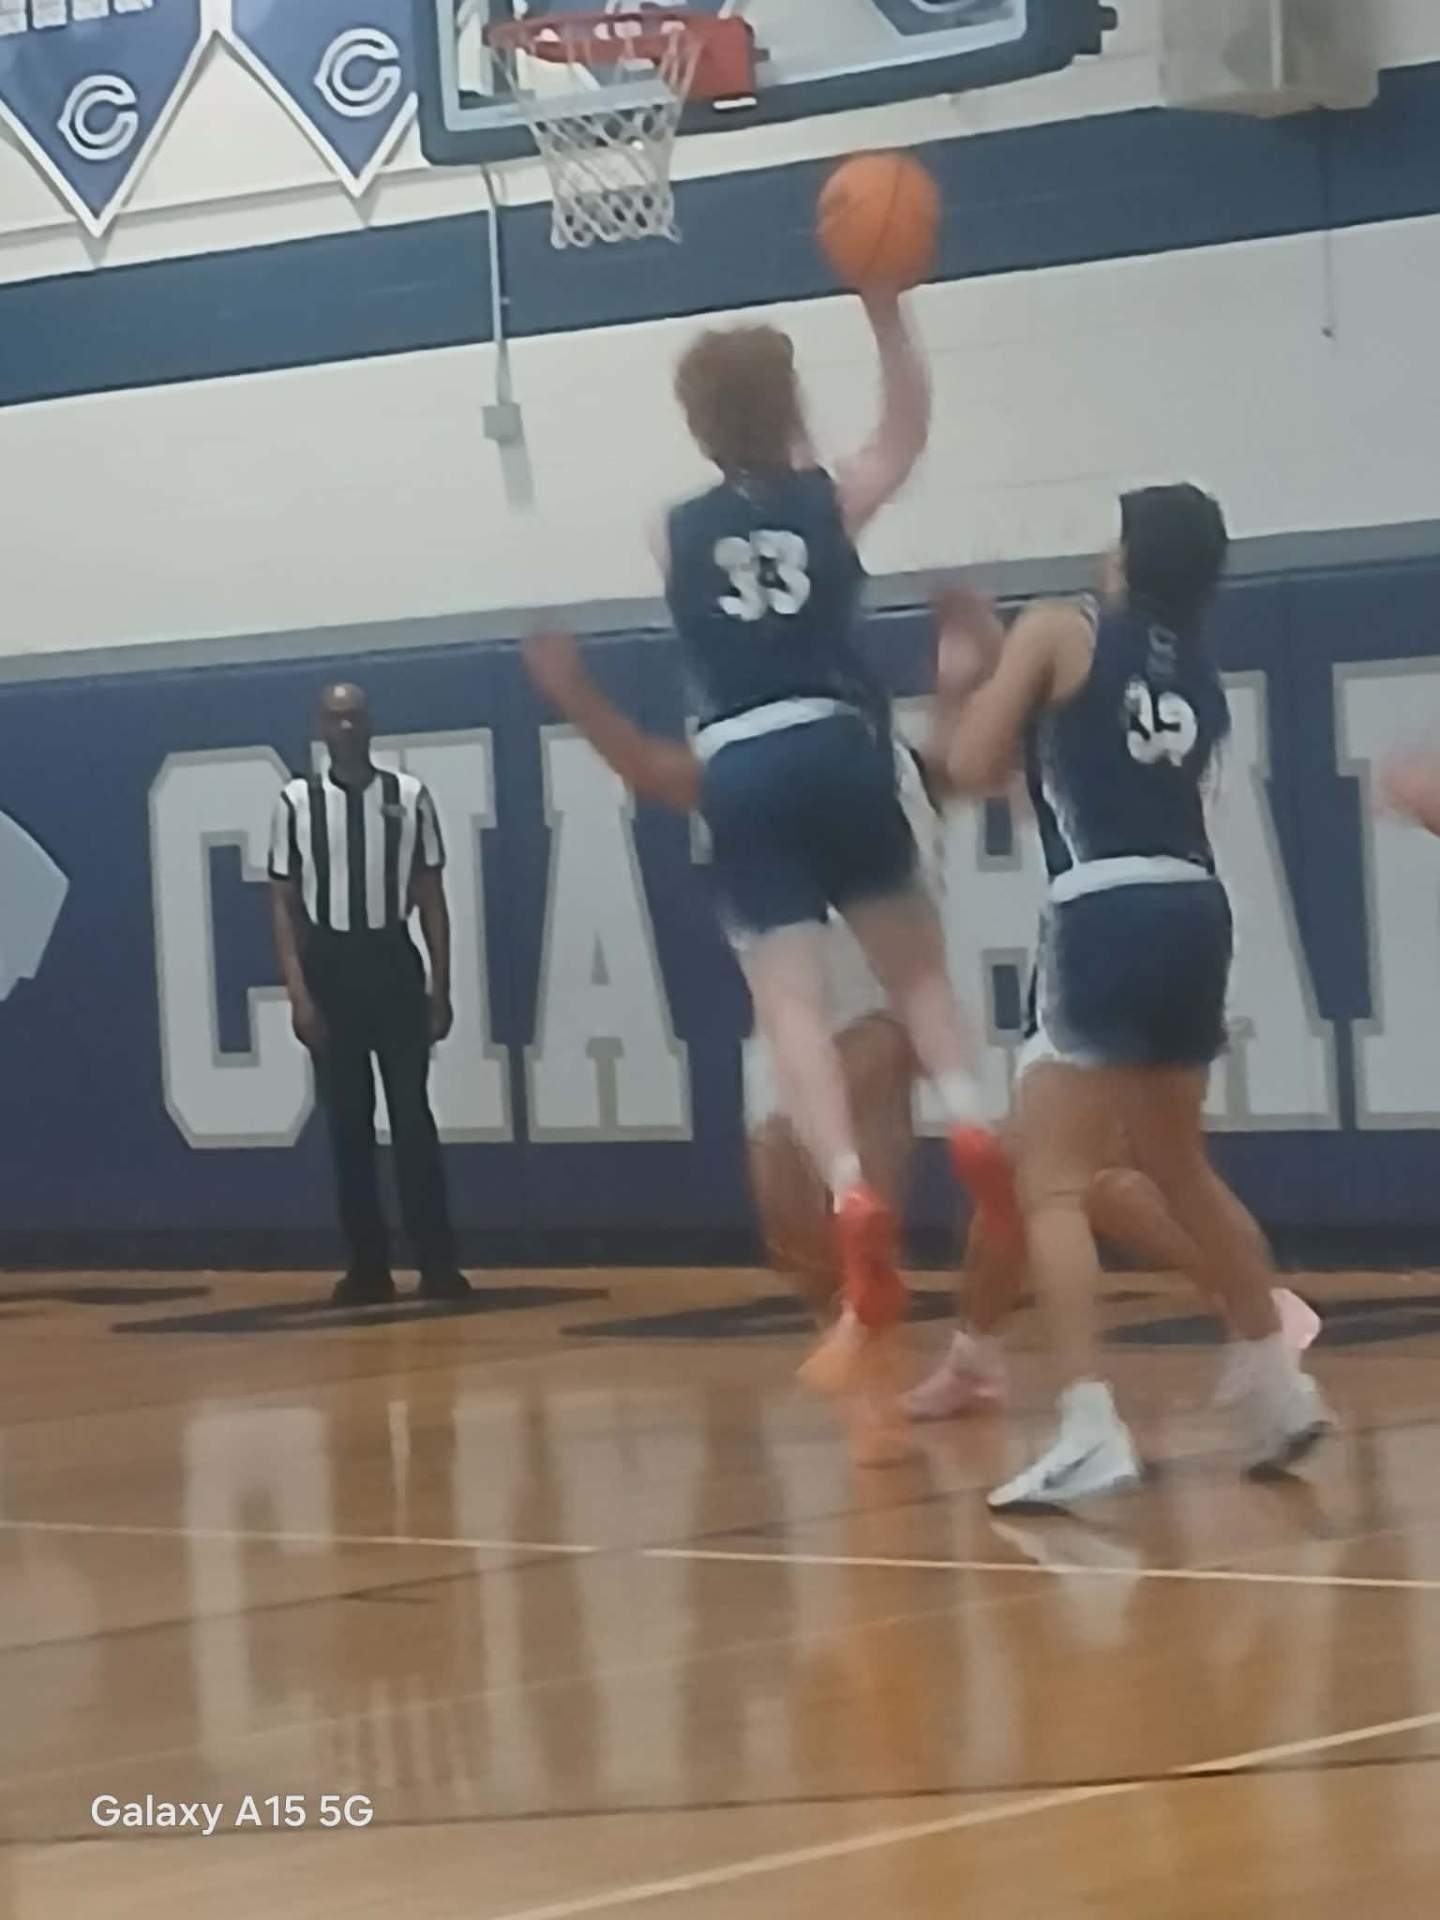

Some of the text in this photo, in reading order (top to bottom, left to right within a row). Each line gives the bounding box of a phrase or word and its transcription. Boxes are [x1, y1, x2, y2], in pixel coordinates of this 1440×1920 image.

[57, 74, 139, 160] C
[314, 28, 401, 117] C
[714, 529, 811, 622] 33
